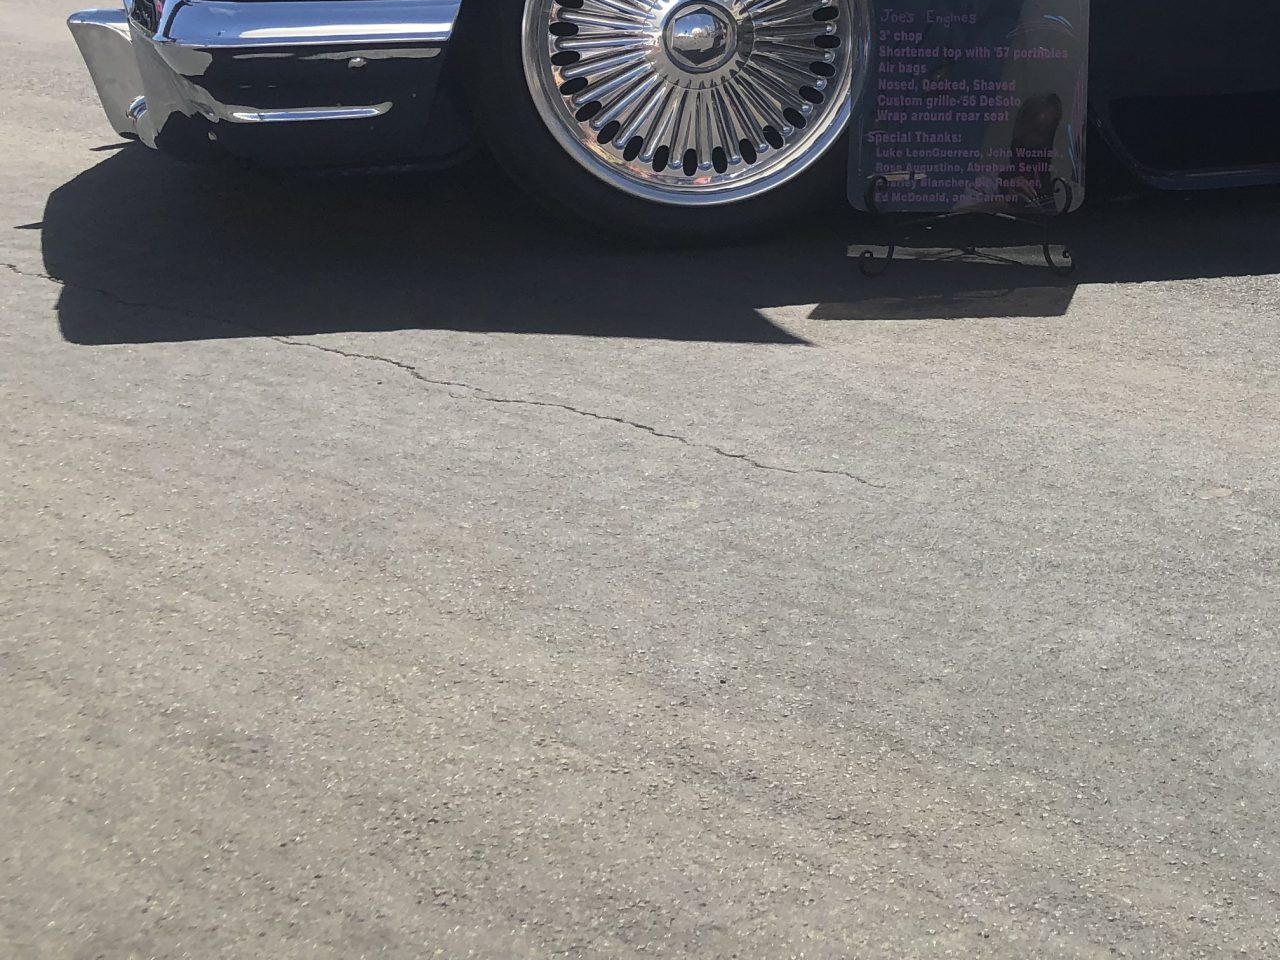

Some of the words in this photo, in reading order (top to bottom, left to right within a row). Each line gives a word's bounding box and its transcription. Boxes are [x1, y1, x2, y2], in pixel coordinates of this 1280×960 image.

[926, 9, 977, 28] Engines
[893, 31, 923, 44] chop
[879, 46, 939, 58] Shortened
[942, 47, 962, 60] top
[965, 46, 991, 58] with
[1013, 47, 1069, 61] portholes
[878, 62, 896, 73] Air
[899, 62, 927, 76] bags
[878, 79, 918, 93] Nosed,
[973, 80, 1016, 91] Shaved
[877, 95, 922, 107] Custom
[980, 96, 1021, 107] DeSoto
[877, 110, 907, 124] Wrap
[910, 110, 953, 121] around
[956, 112, 980, 122] rear
[983, 111, 1009, 122] seat
[867, 131, 911, 145] Special
[915, 132, 962, 143] Thanks:
[876, 148, 902, 158] Luke
[986, 148, 1013, 158] John
[967, 163, 1015, 173] Abraham
[875, 193, 889, 202] Ed
[891, 193, 949, 204] McDonald,
[952, 193, 973, 202] and
